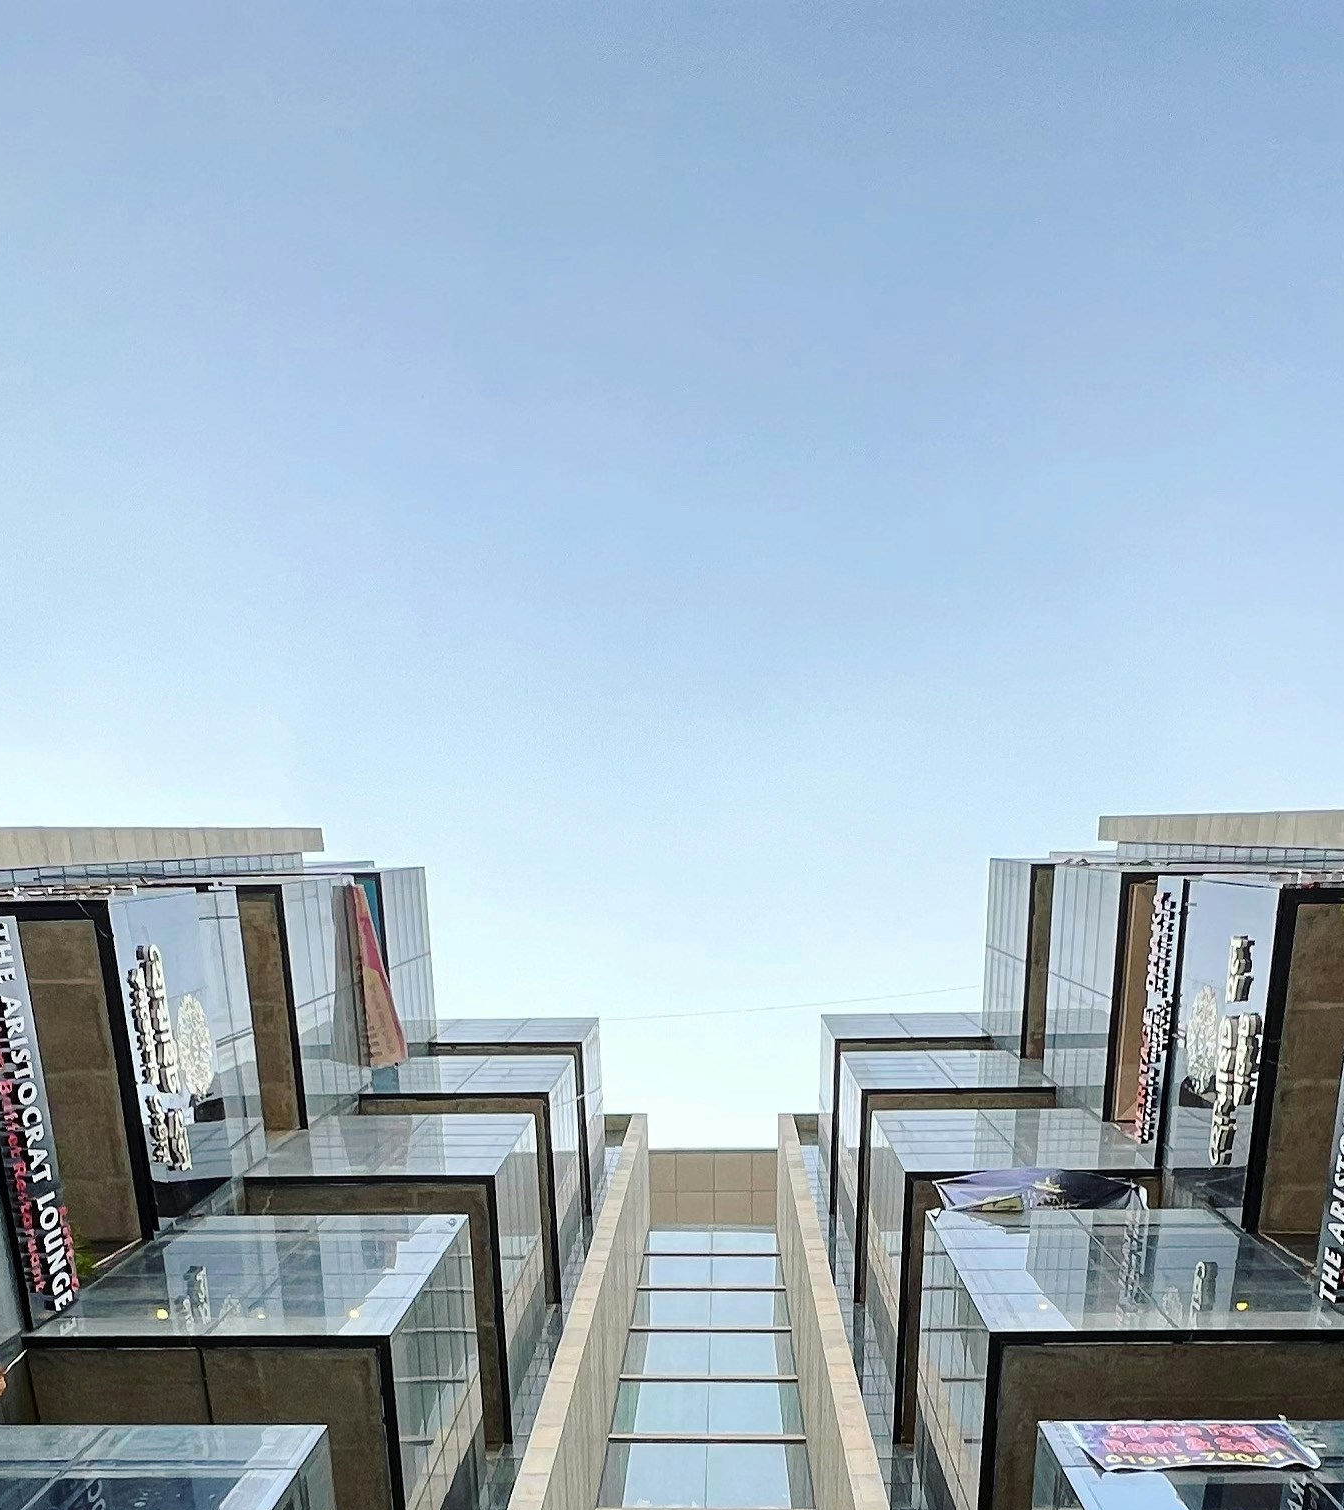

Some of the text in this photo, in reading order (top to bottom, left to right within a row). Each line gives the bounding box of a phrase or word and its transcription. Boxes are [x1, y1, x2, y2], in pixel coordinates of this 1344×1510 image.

[1134, 1007, 1154, 1144] MERITAGE
[1145, 890, 1164, 992] DHAKA
[1142, 1067, 1156, 1141] ULTIMATE
[0, 992, 53, 1184] ARISTOCRAT
[37, 1191, 76, 1311] LOUNGE
[1318, 1246, 1343, 1304] THE
[1101, 1439, 1182, 1453] Rent
[1185, 1437, 1215, 1450] &
